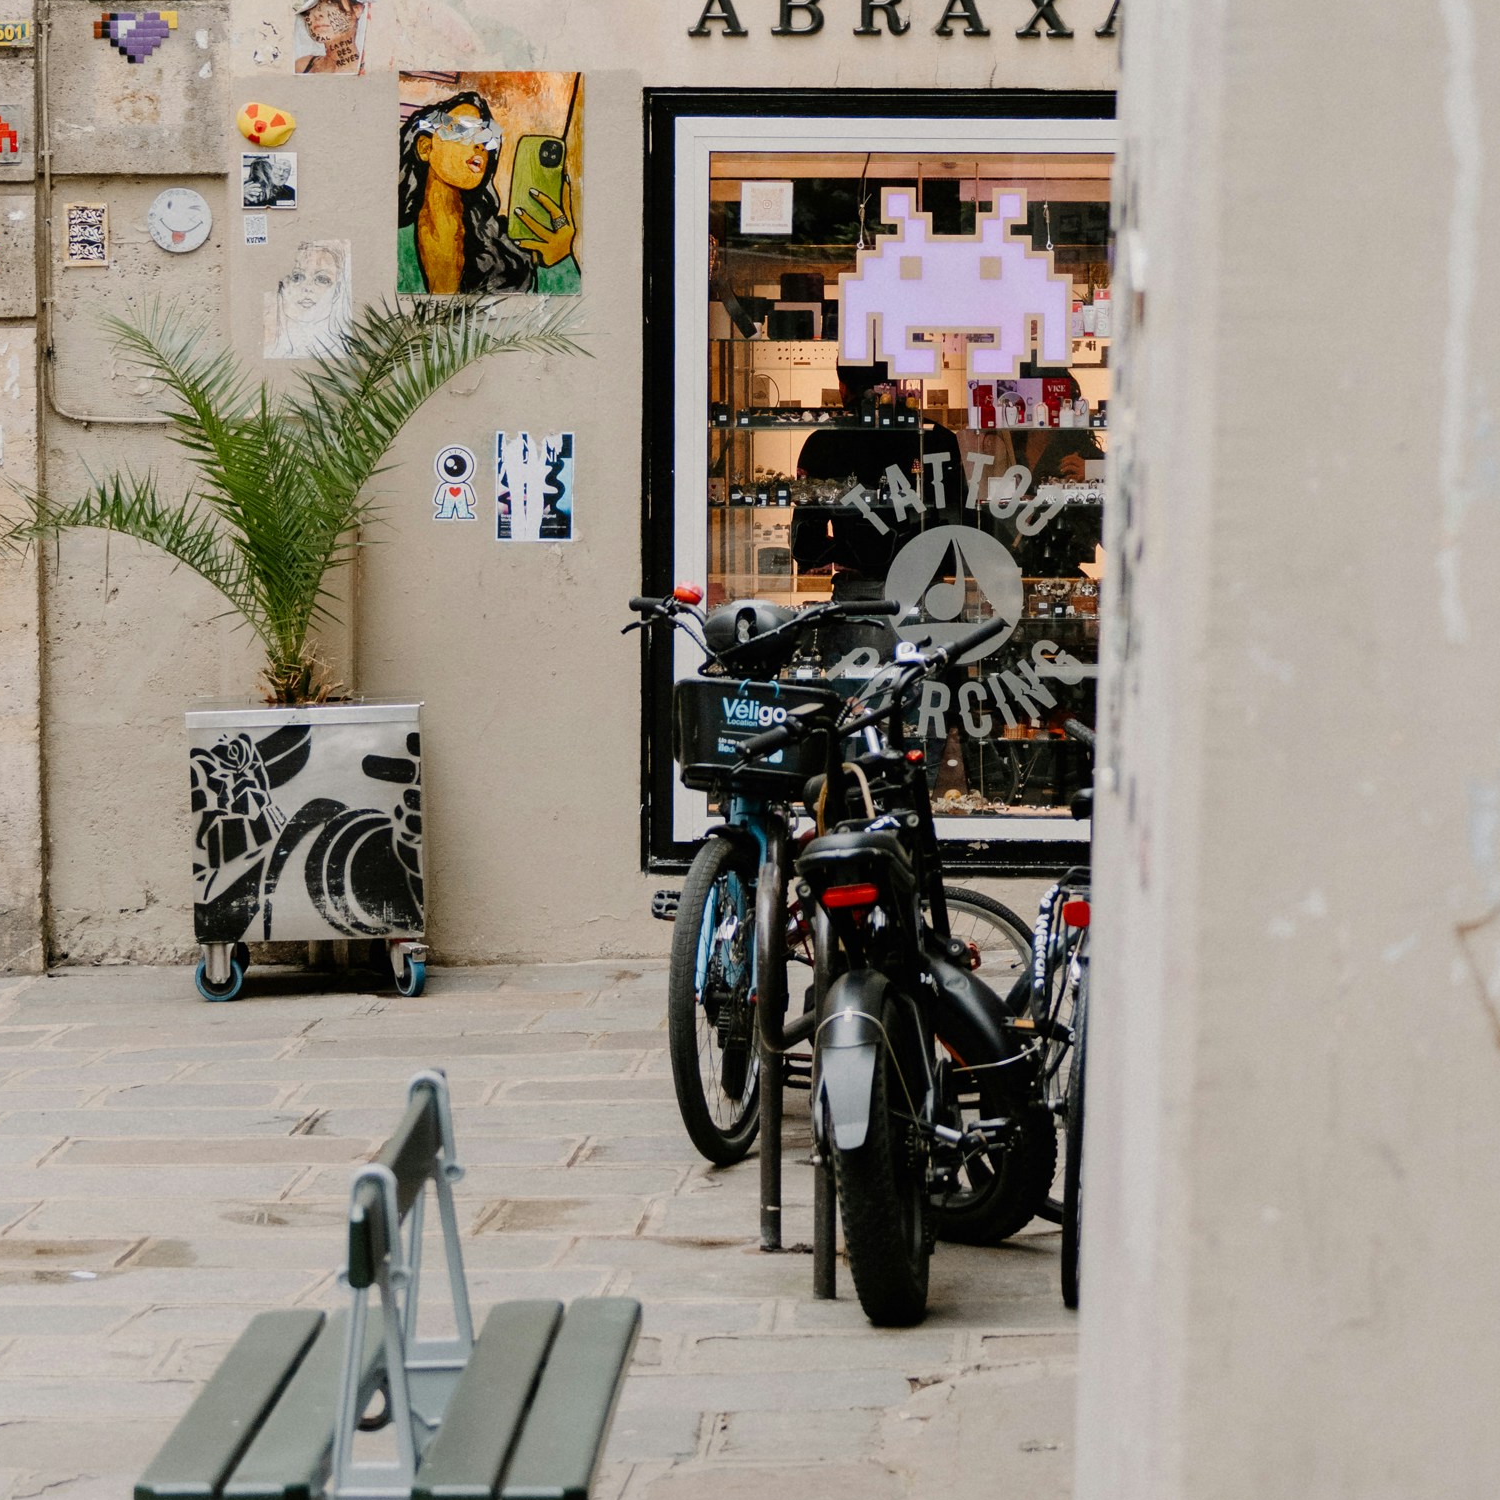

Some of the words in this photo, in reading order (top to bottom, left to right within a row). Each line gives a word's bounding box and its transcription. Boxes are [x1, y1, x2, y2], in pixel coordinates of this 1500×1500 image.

[1047, 384, 1066, 393] VICE
[840, 451, 1067, 537] TATTOO
[722, 697, 787, 726] Véligo
[727, 717, 758, 726] Location
